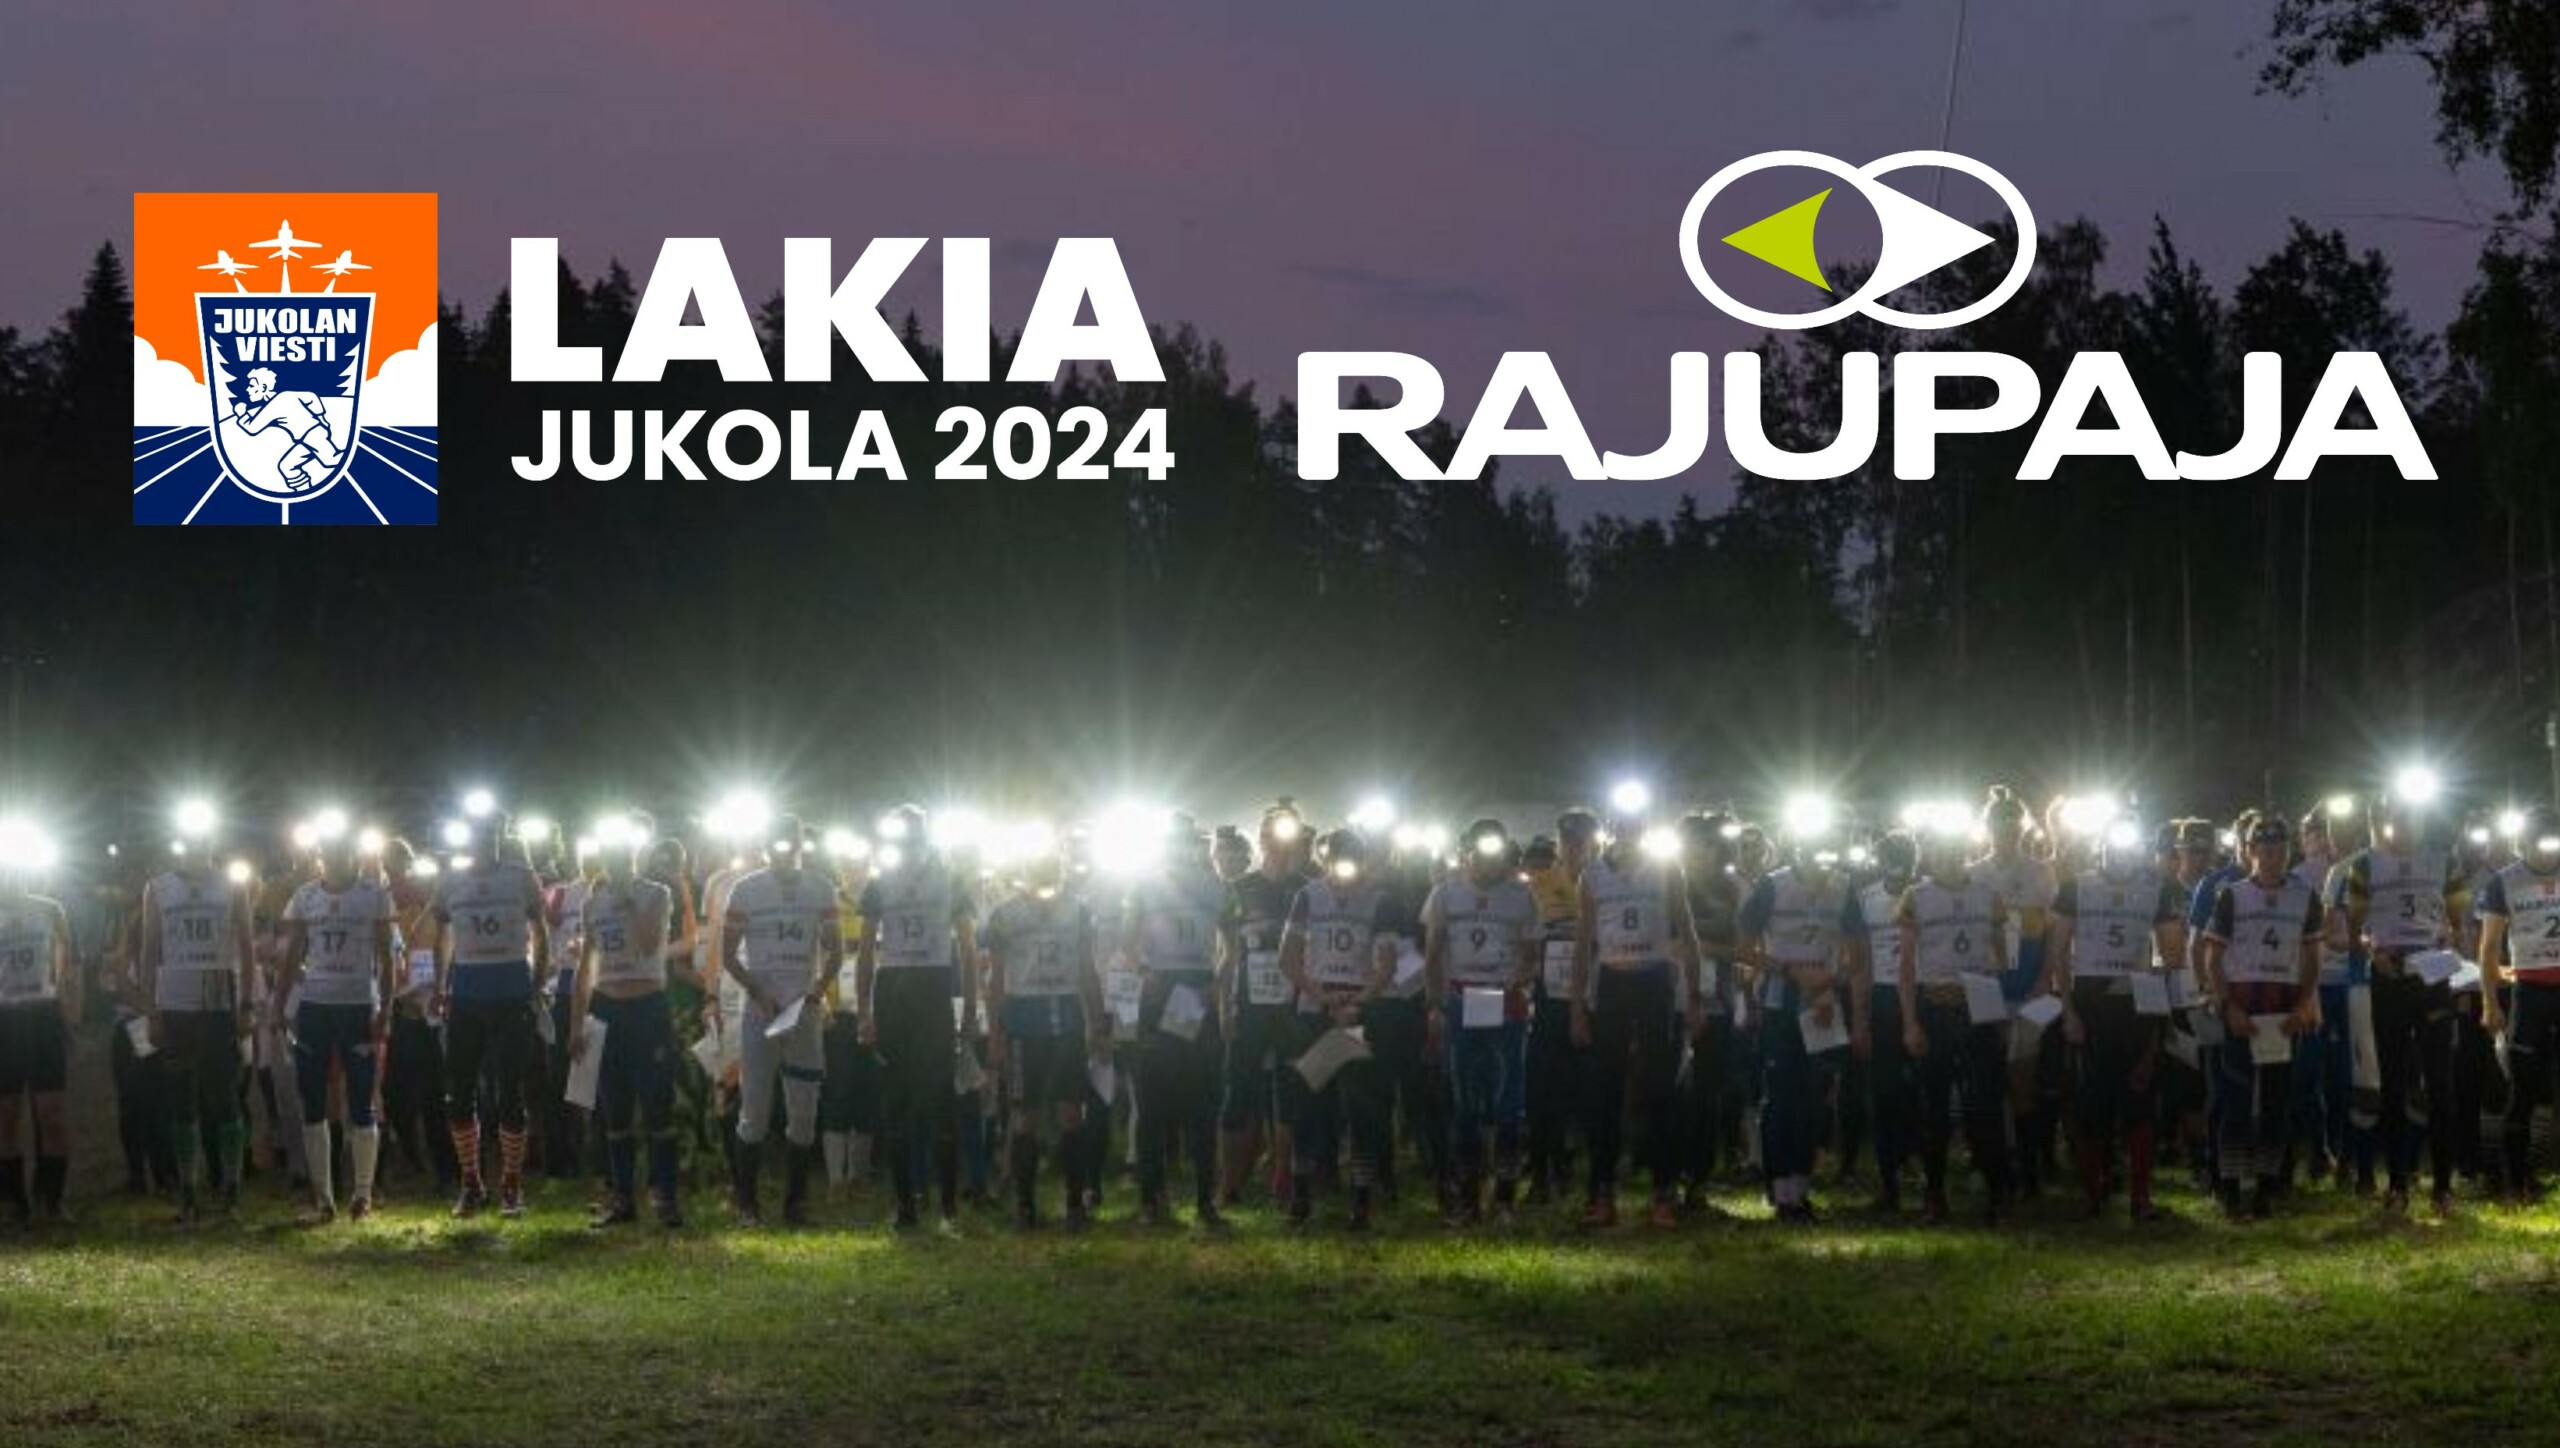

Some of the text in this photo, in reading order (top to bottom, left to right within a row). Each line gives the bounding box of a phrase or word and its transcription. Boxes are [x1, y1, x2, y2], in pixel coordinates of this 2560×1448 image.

[2400, 894, 2416, 918] 3
[472, 914, 499, 936] 16
[1623, 907, 1639, 930] 8
[323, 930, 348, 952] 17
[777, 920, 802, 942] 14
[1326, 928, 1354, 952] 10
[1470, 927, 1486, 950] 9
[1953, 929, 1971, 953] 6
[2107, 925, 2124, 949] 5
[2263, 926, 2280, 951] 4
